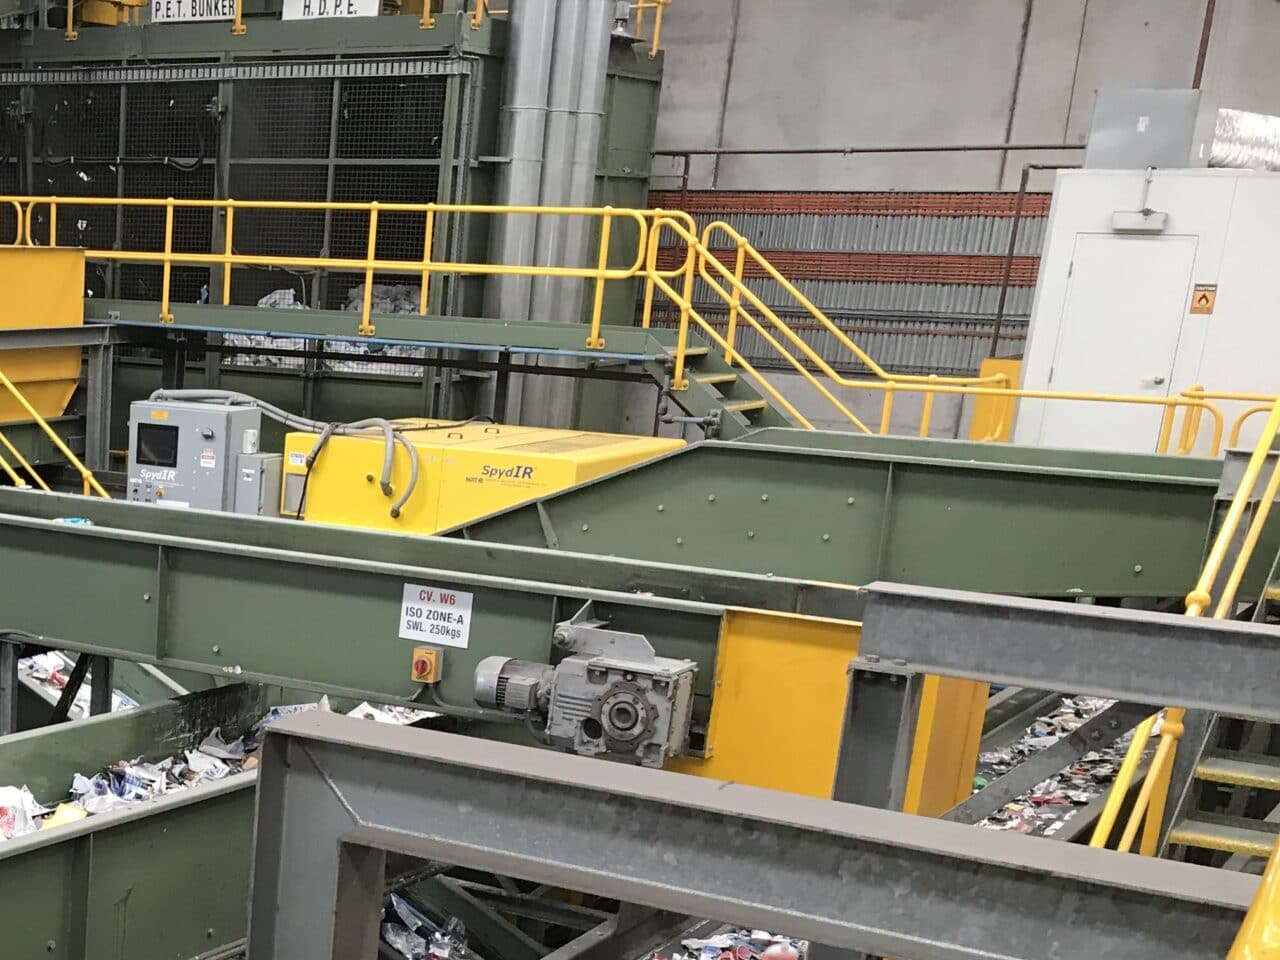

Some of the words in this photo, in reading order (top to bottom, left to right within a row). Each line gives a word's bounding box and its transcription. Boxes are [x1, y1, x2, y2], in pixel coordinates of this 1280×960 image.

[155, 0, 186, 19] P.E.T.
[191, 0, 235, 17] BUNKER
[481, 464, 534, 480] SpydIR
[419, 589, 435, 602] CV.
[440, 592, 457, 606] W6
[405, 605, 423, 619] ISO
[406, 619, 427, 633] SWL.
[429, 623, 462, 640] 250kgs
